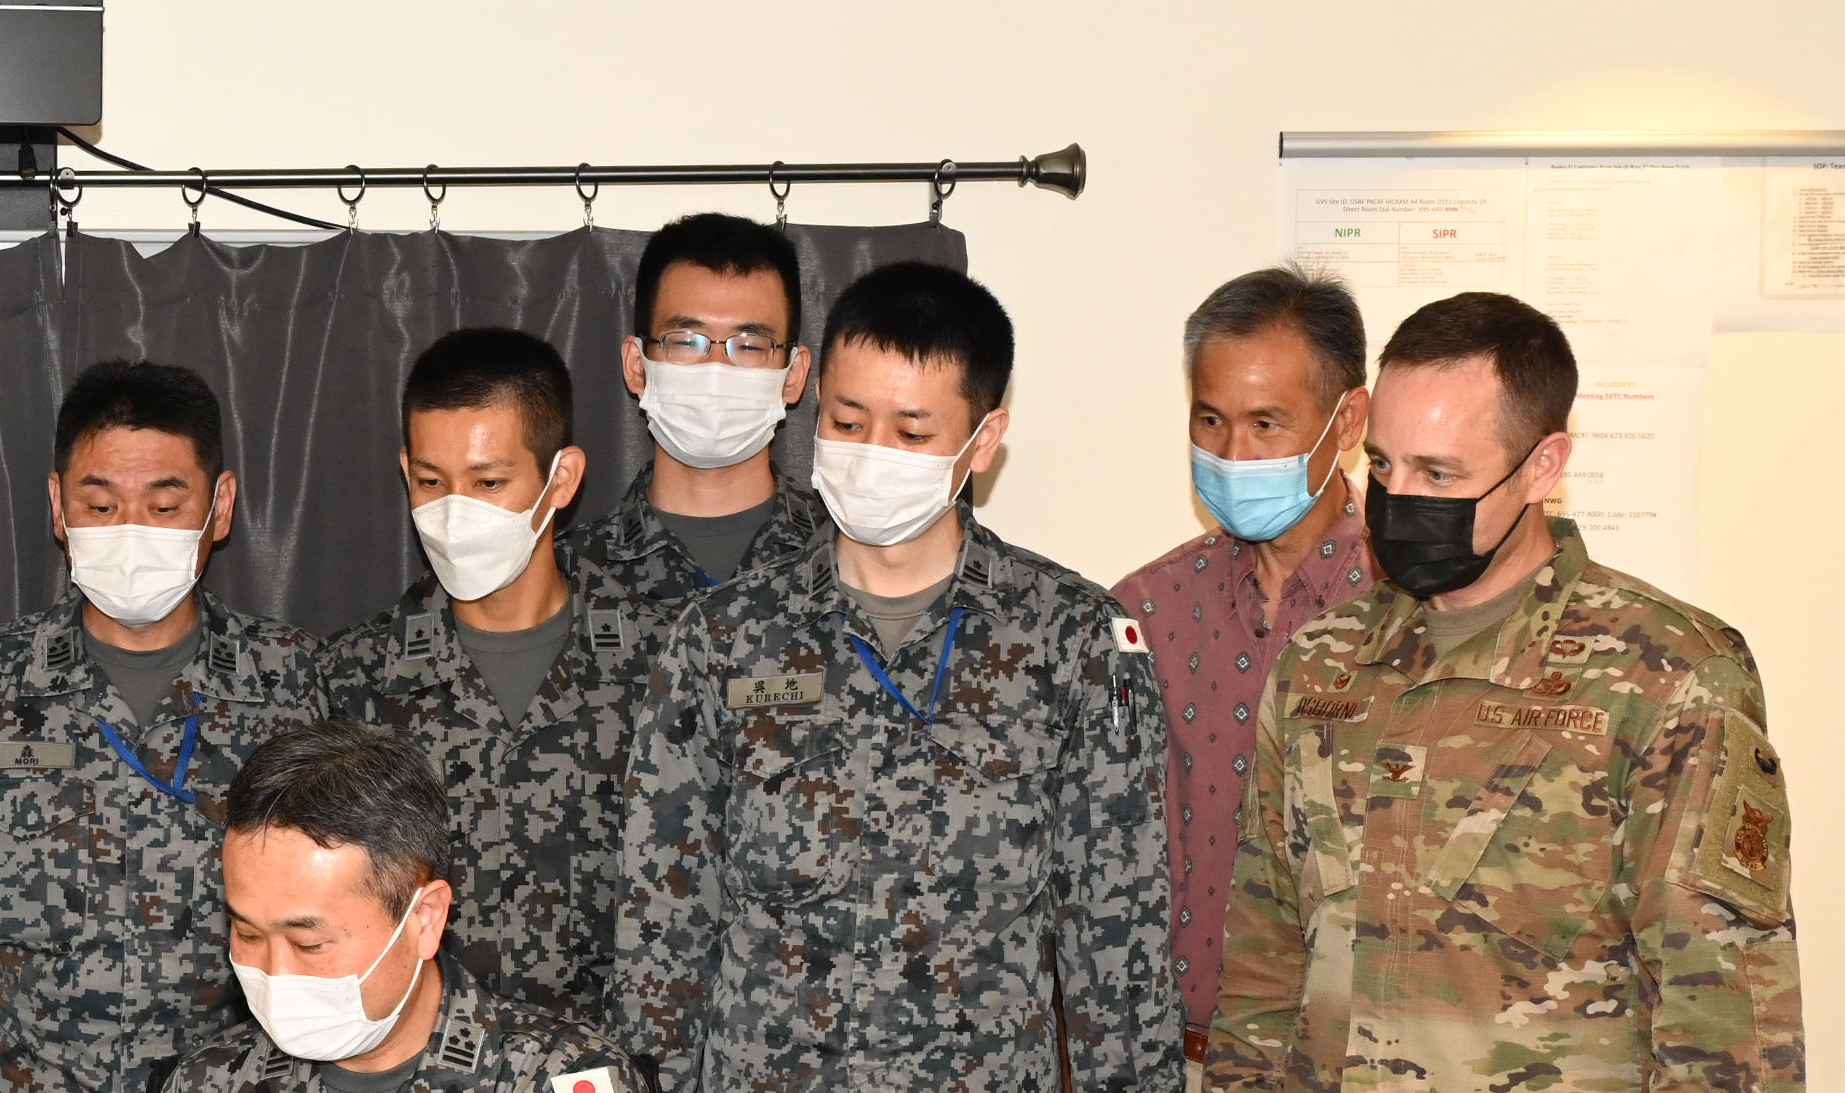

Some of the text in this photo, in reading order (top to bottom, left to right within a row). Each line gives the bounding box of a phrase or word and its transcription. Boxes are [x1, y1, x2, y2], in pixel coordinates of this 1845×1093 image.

[1335, 228, 1361, 238] NIPR
[1432, 229, 1457, 239] SIPR
[745, 691, 804, 704] KURECHI
[1511, 707, 1543, 727] AIR
[1544, 709, 1605, 733] FORCE
